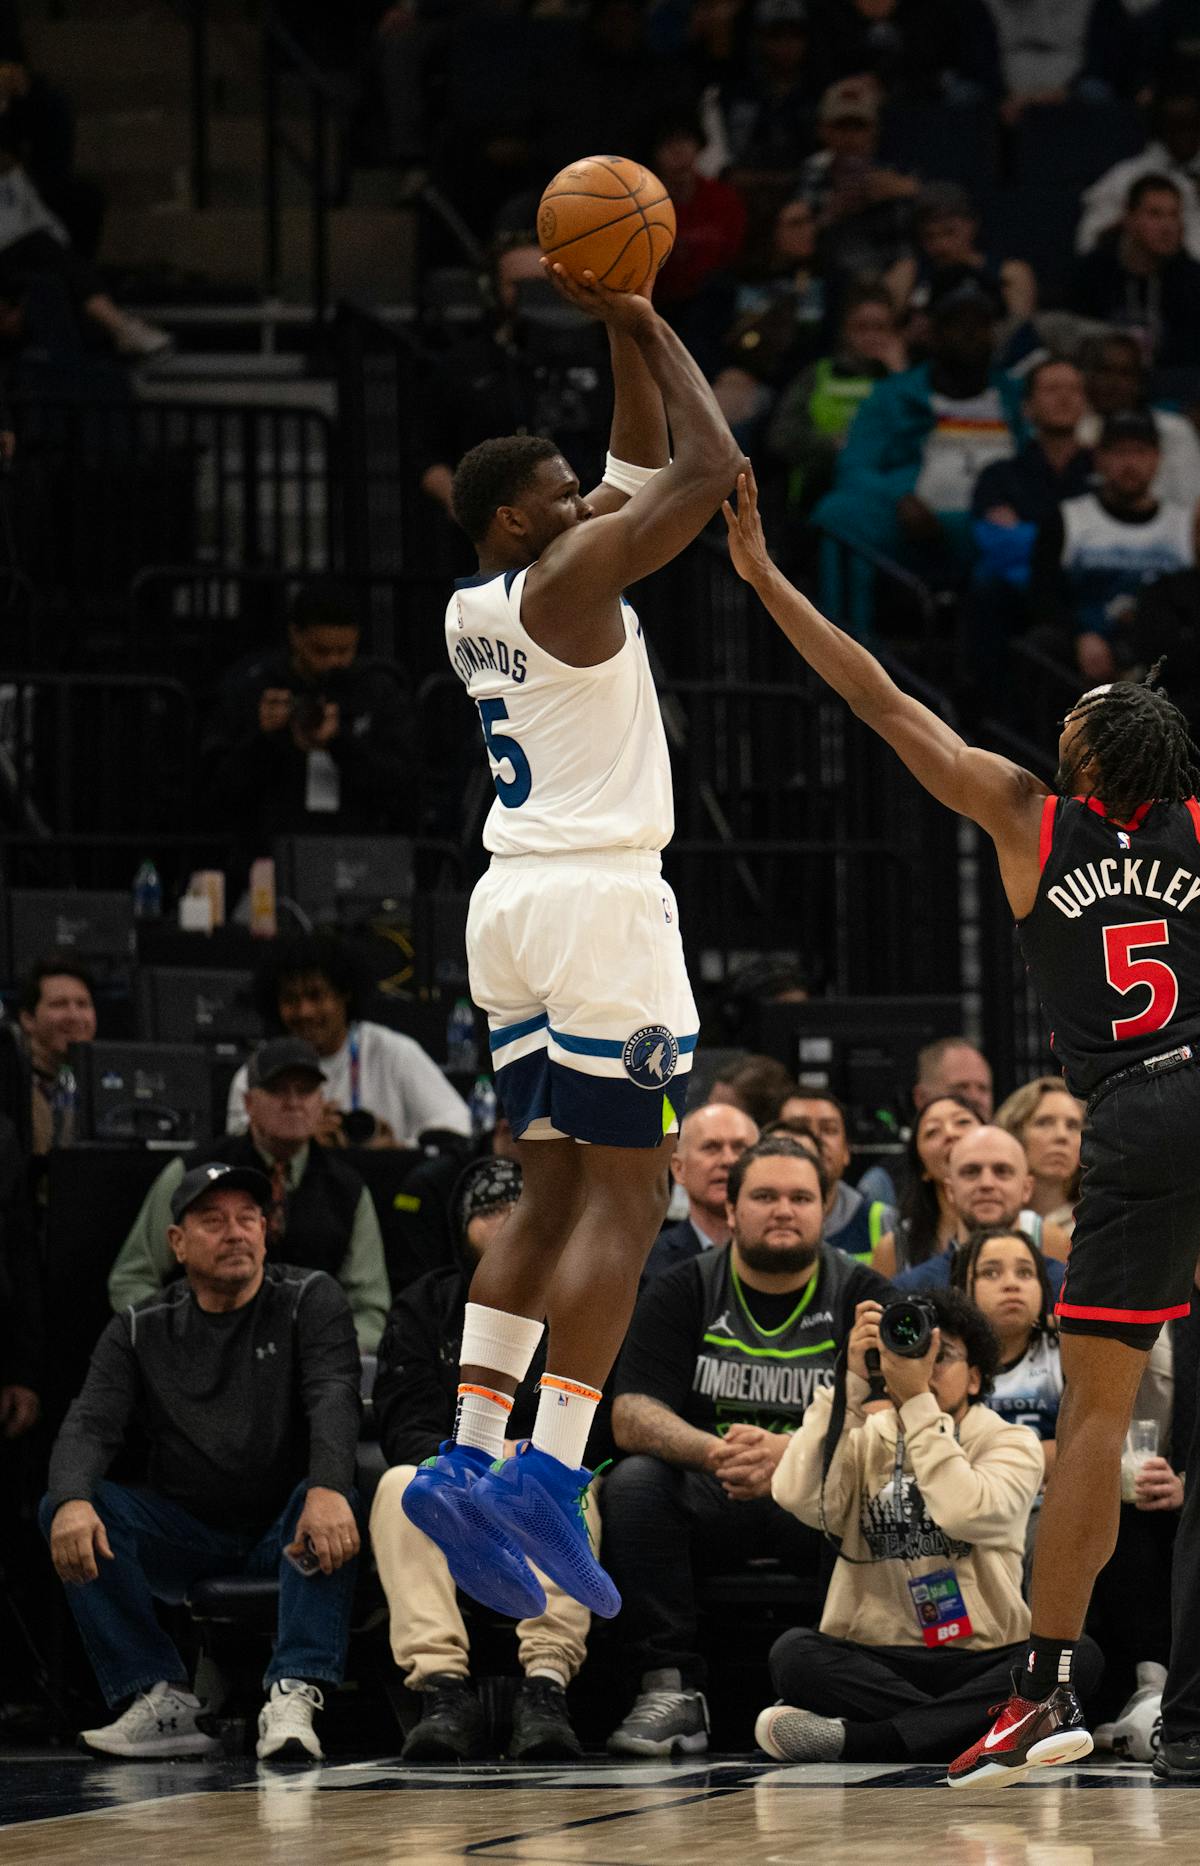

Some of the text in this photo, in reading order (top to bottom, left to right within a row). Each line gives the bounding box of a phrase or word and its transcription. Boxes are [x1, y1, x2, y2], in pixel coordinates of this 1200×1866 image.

[477, 697, 532, 809] 5
[1102, 918, 1179, 1041] 5
[984, 1398, 1047, 1412] ESOTA
